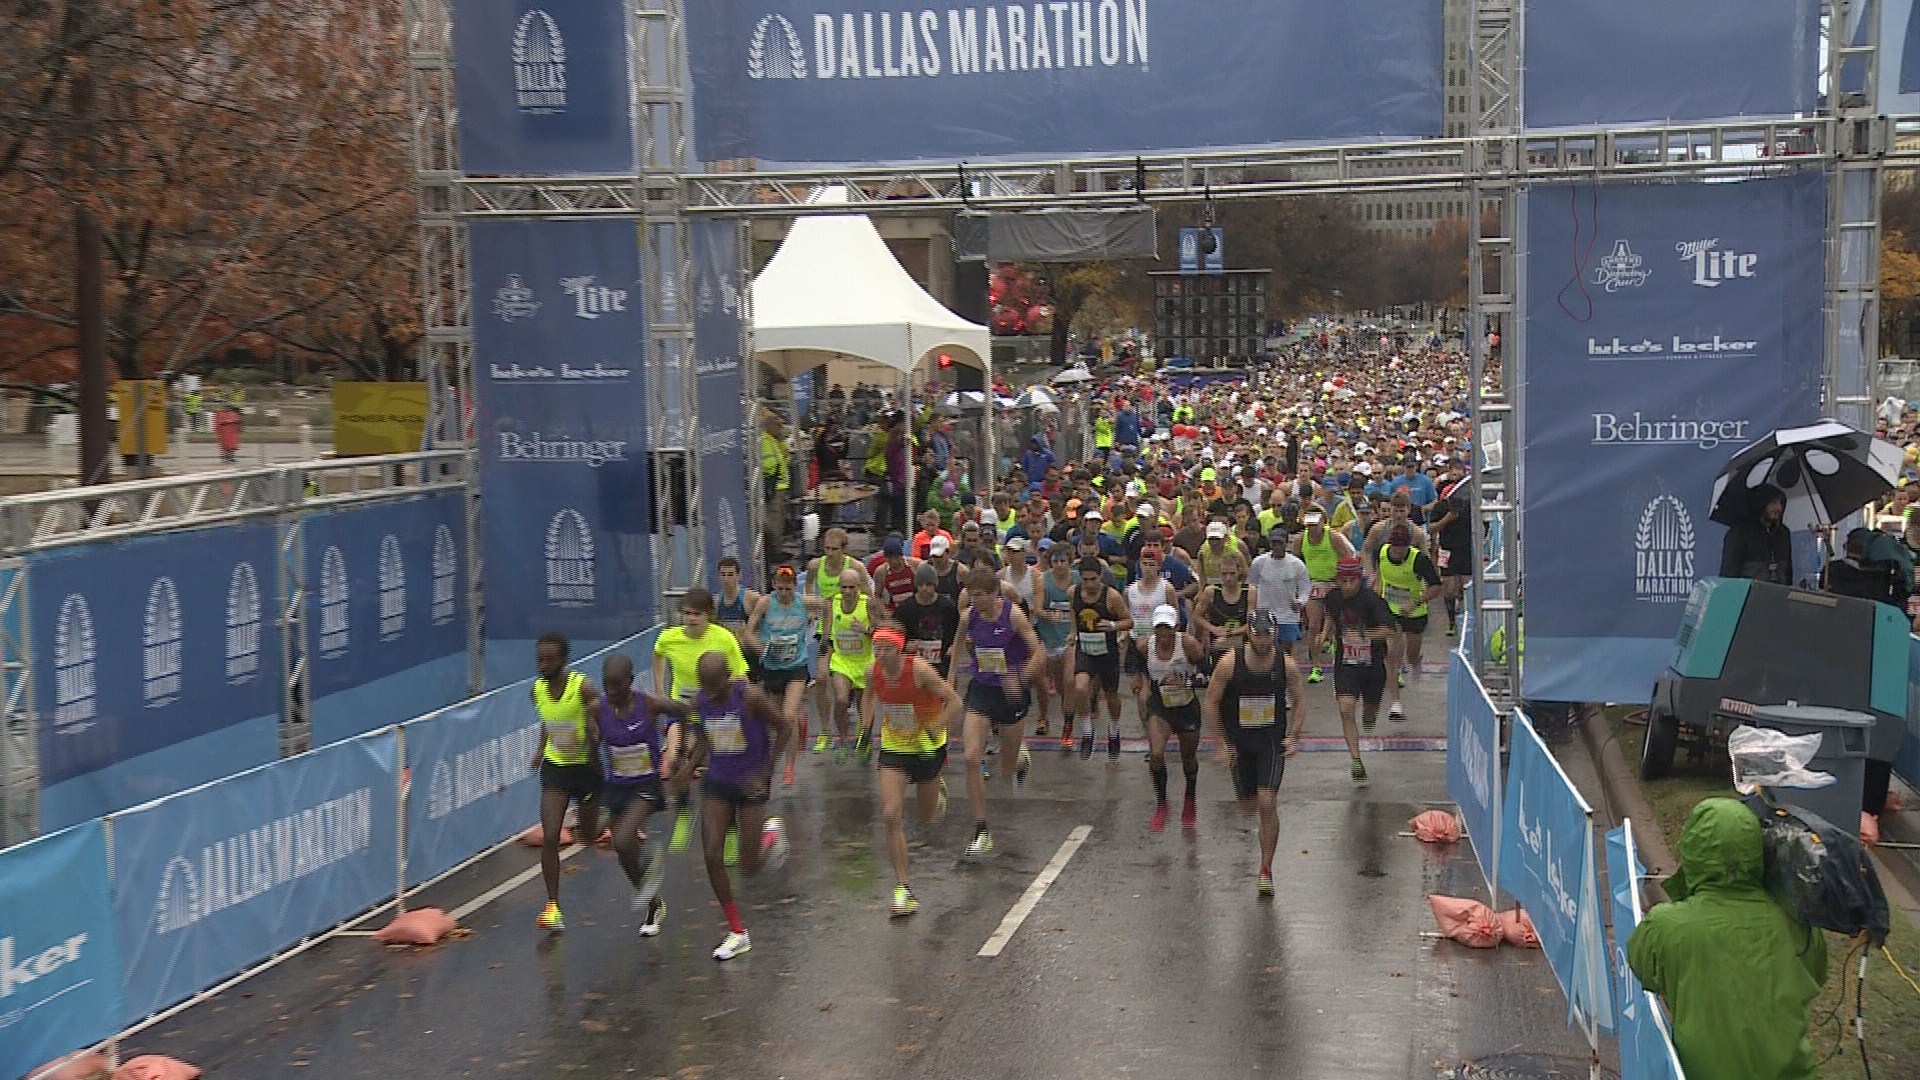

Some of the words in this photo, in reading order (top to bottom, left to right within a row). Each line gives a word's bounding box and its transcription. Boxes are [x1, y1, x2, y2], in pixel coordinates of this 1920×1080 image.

[813, 10, 941, 79] DALLAS
[947, 0, 1149, 75] MARATHON
[514, 63, 567, 91] DALLAS
[1675, 237, 1720, 262] Miller
[1692, 249, 1758, 287] Lite
[575, 285, 628, 320] Lite
[1592, 411, 1750, 449] Behringer
[499, 431, 628, 468] Behringer
[546, 560, 595, 584] DALLAS
[1636, 550, 1694, 578] DALLAS
[1636, 578, 1693, 594] MARATHON
[199, 822, 275, 919] DALLAS
[273, 786, 372, 886] MARATHON
